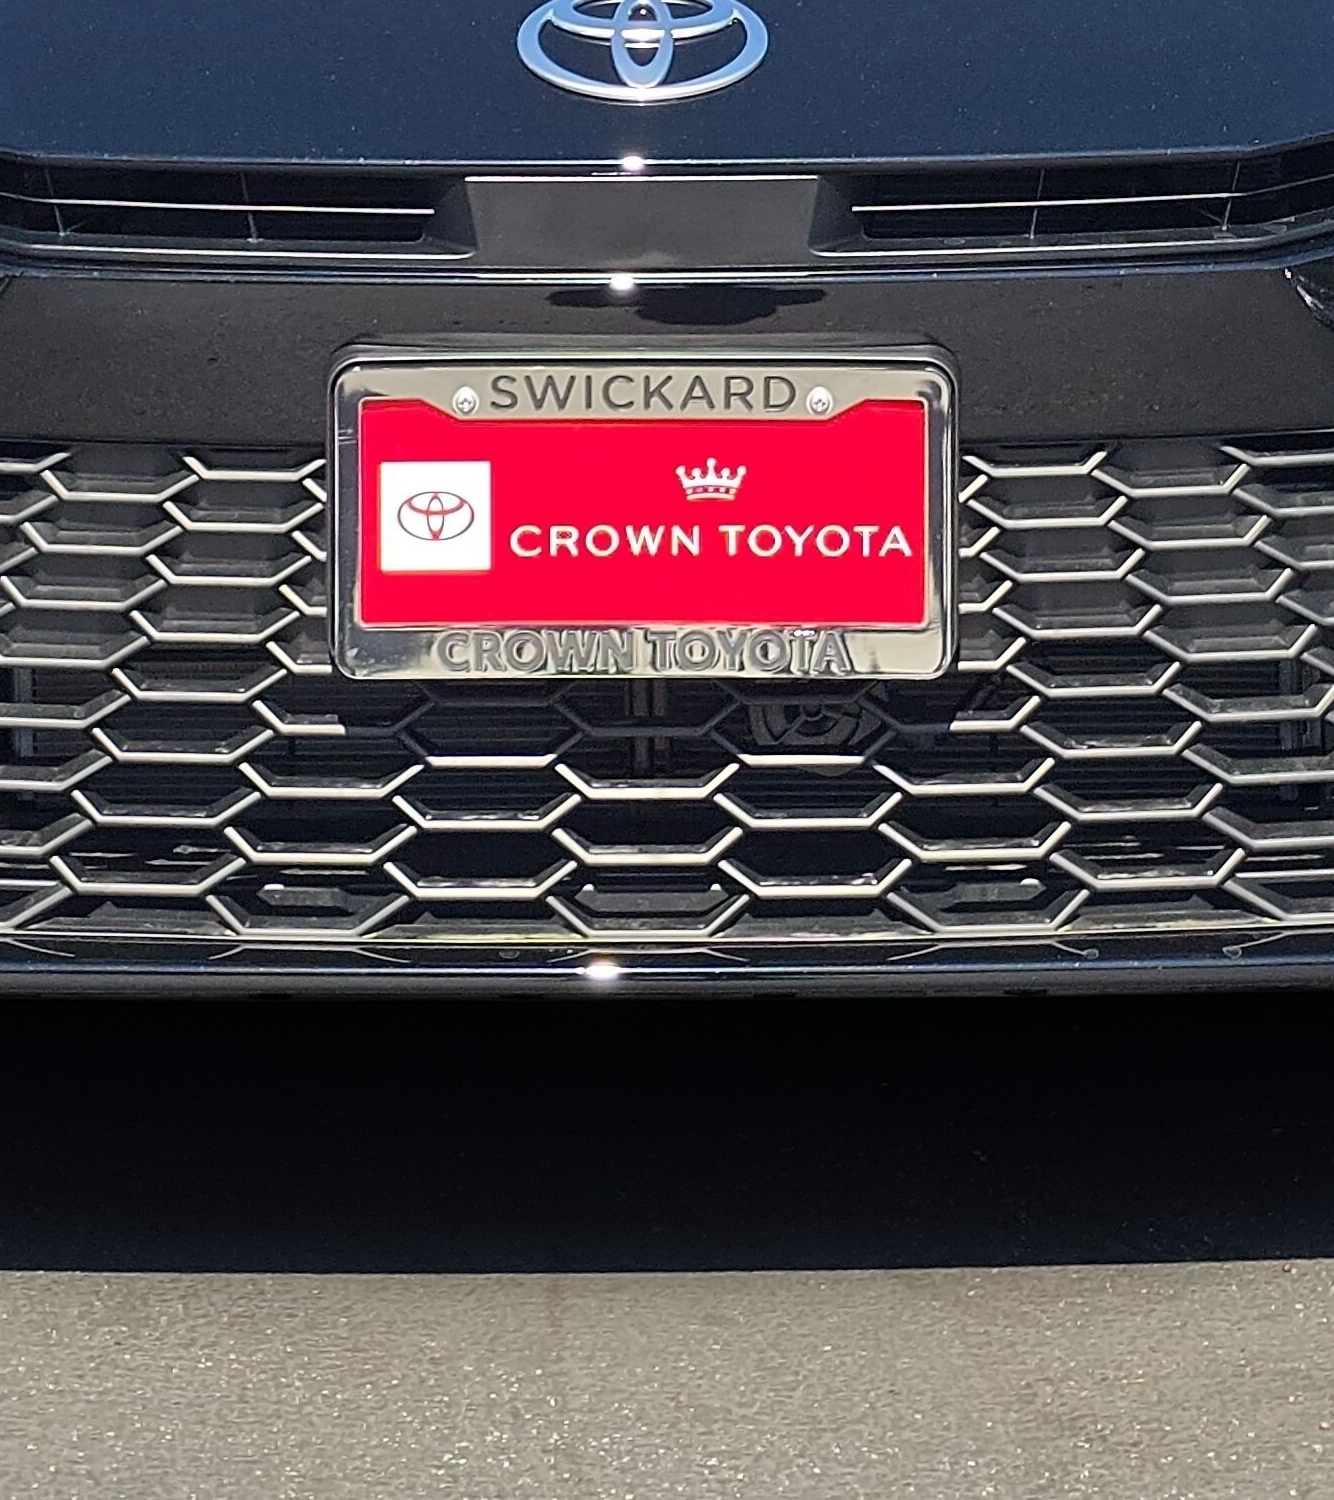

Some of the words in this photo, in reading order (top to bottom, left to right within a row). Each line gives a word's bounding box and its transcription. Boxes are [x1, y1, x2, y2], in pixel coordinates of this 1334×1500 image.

[490, 375, 797, 411] SWICKARD
[509, 524, 702, 558] CROWN
[718, 524, 914, 558] TOYOTA
[436, 629, 635, 673] CROWN
[647, 629, 854, 673] TOYOTA
